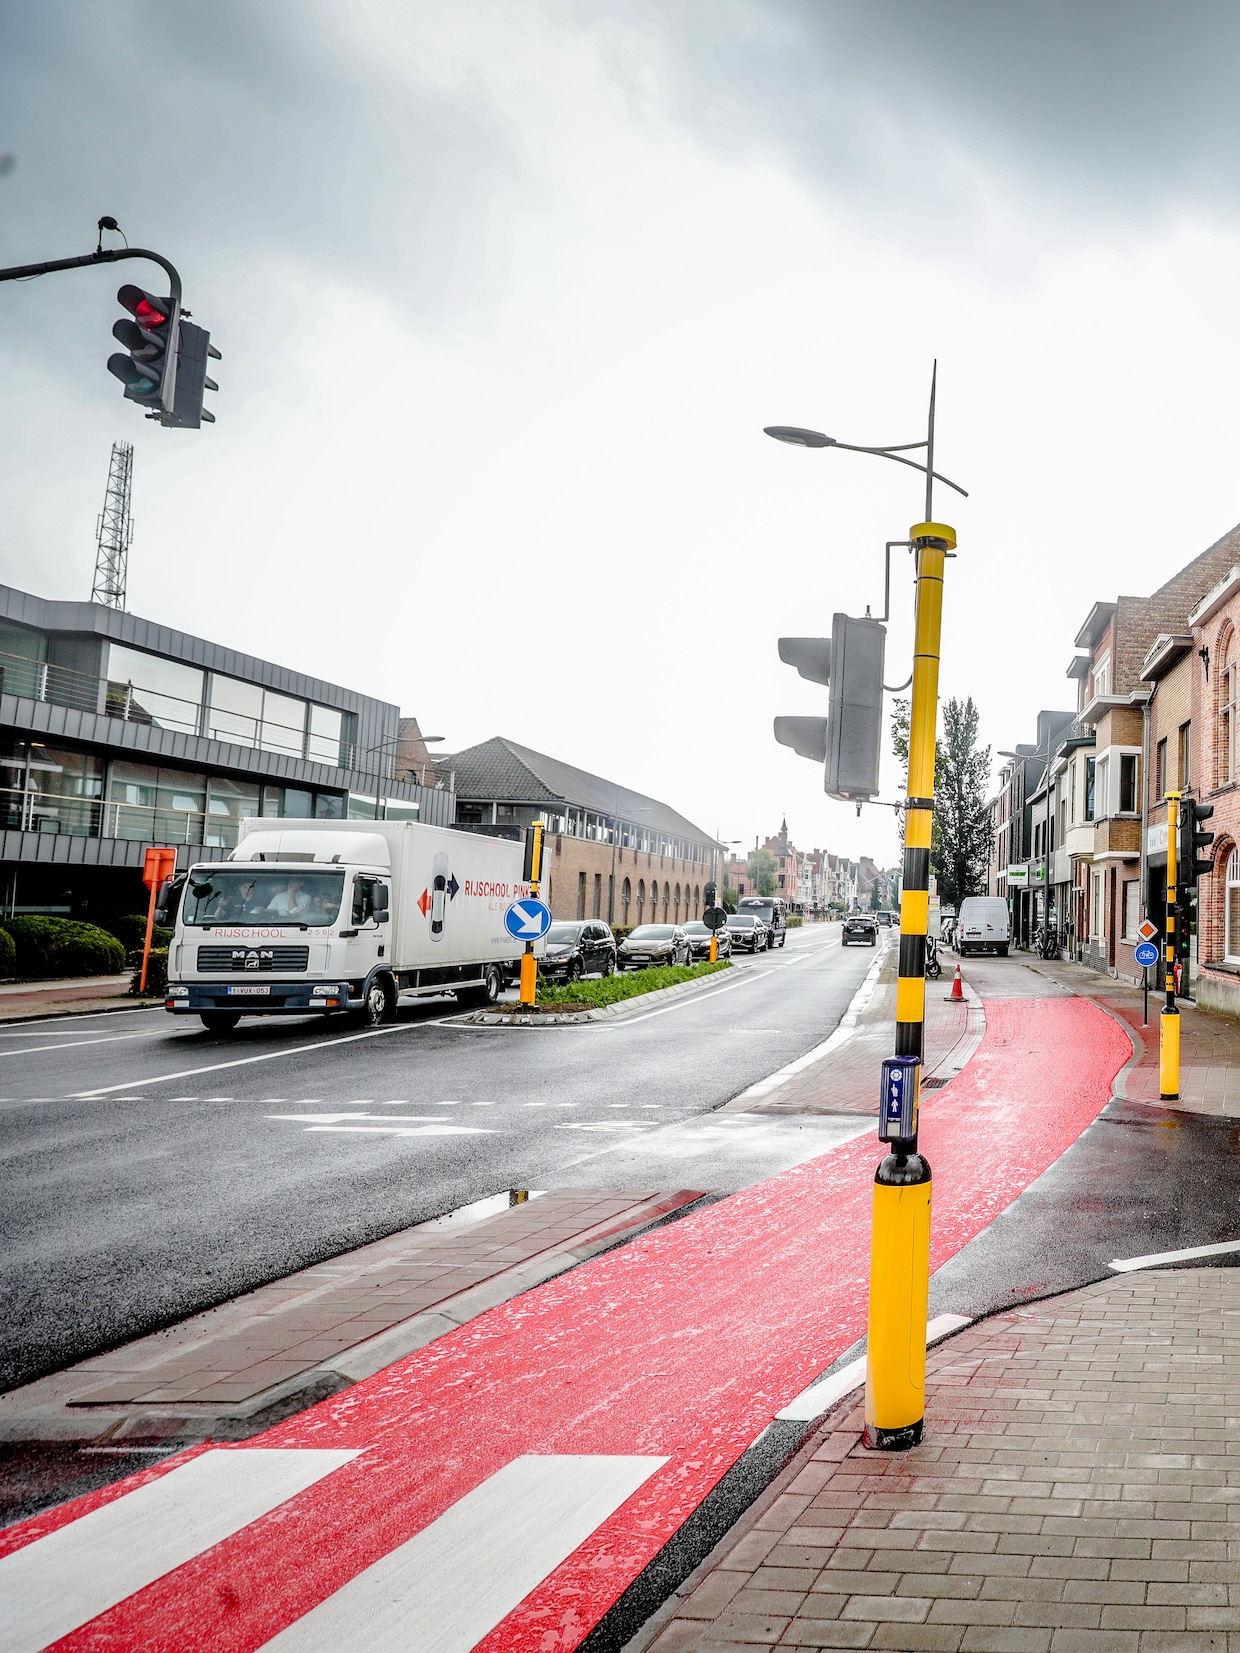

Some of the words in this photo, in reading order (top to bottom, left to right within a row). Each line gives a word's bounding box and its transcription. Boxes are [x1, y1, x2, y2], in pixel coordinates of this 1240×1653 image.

[464, 880, 511, 898] RIJSCHOOL
[513, 884, 541, 899] PINKS
[214, 928, 287, 938] RIJSCHOOL
[231, 950, 274, 959] MAN
